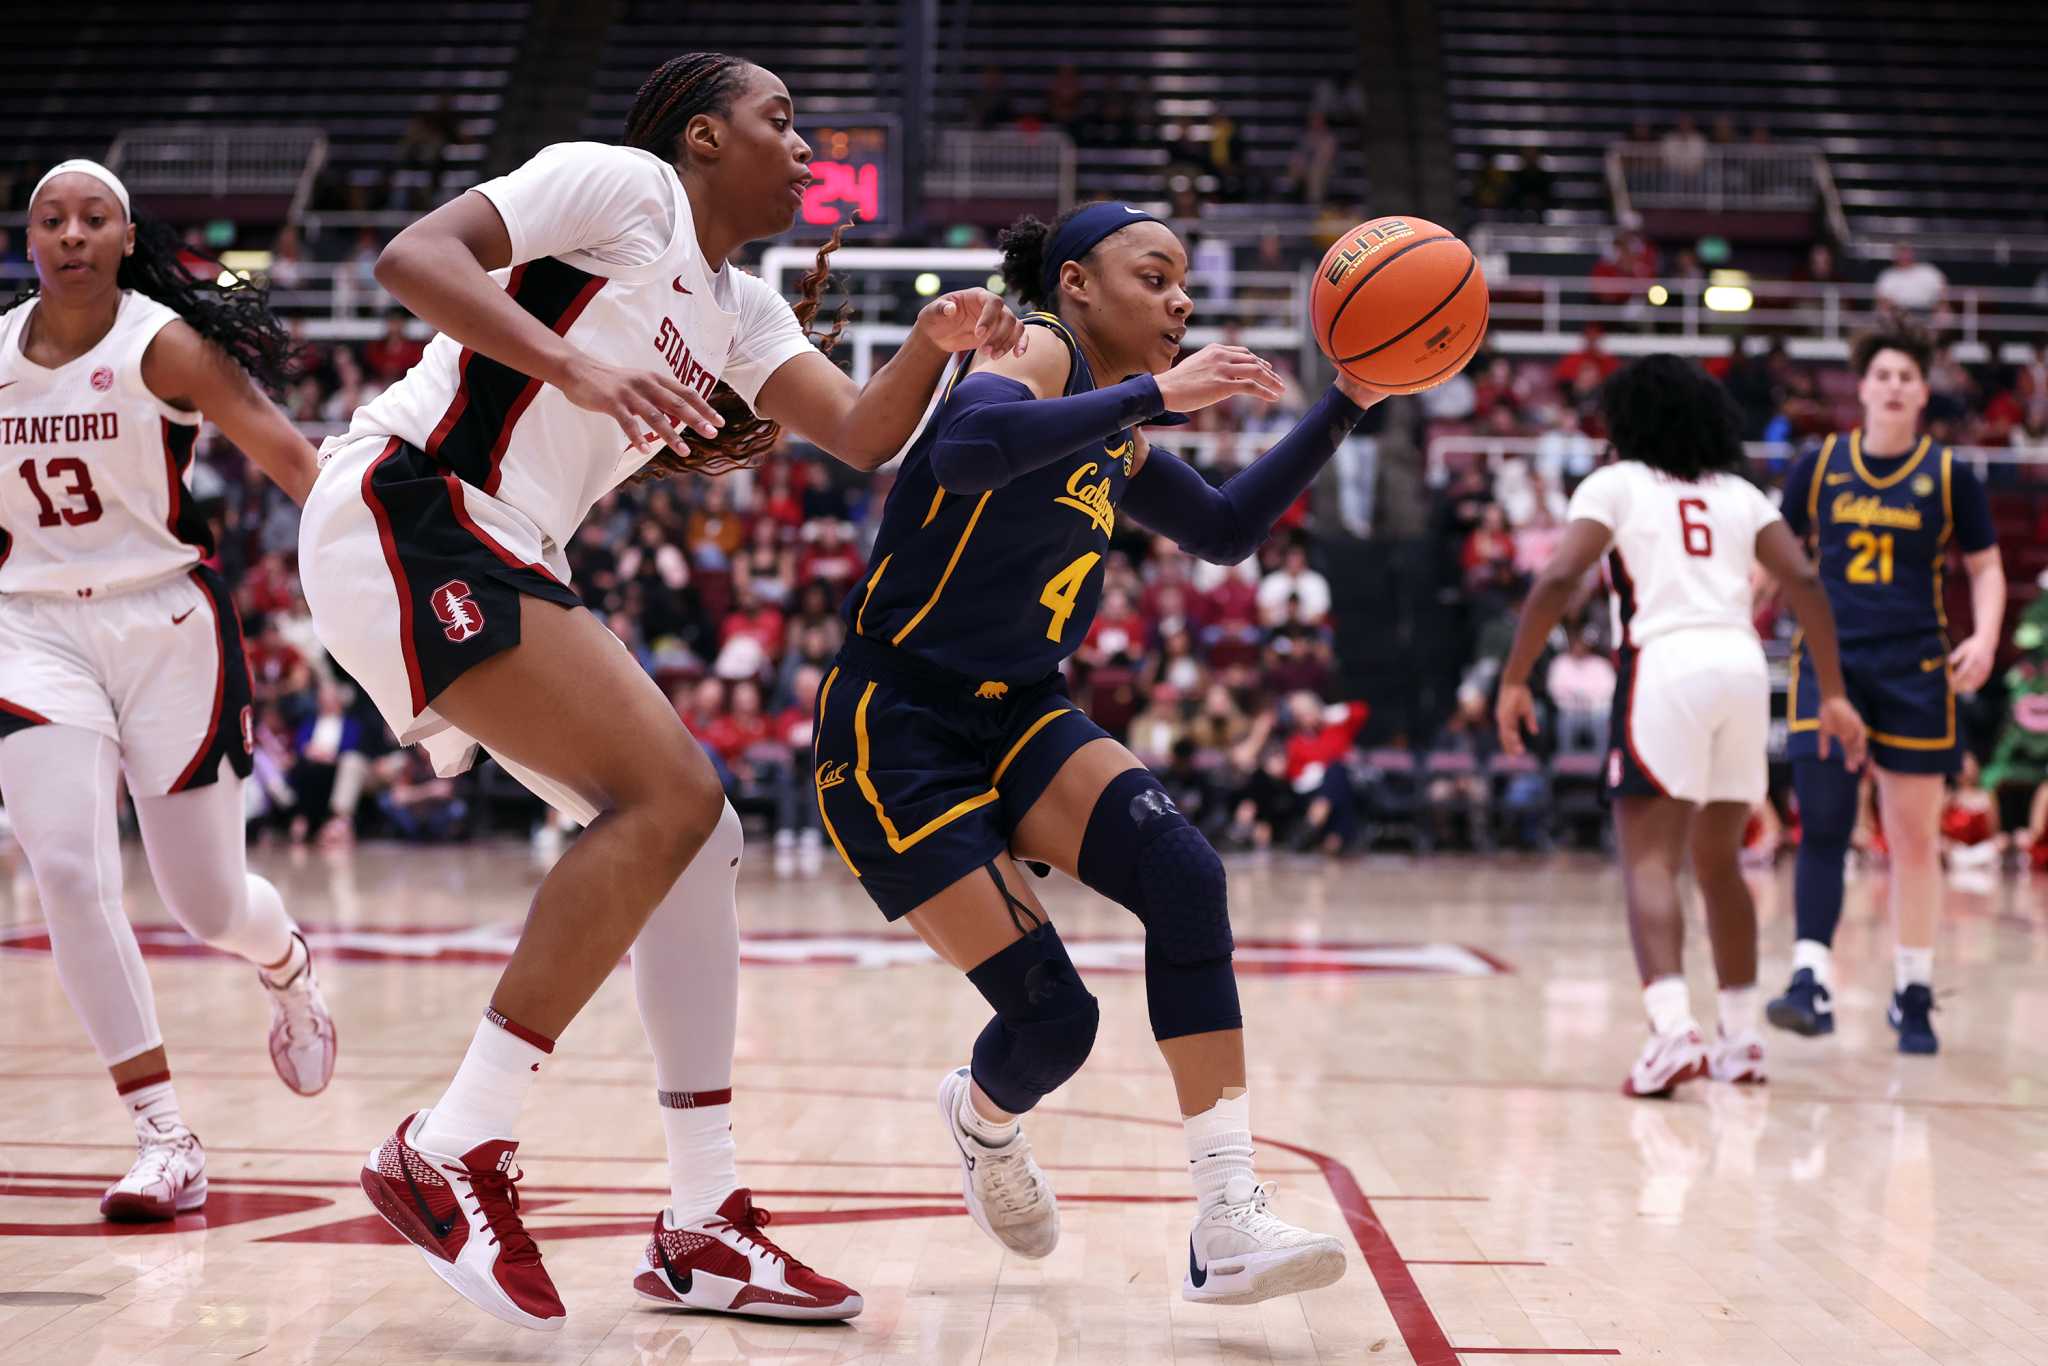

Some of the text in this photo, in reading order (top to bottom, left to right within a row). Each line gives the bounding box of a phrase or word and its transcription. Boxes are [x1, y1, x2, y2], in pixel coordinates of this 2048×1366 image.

[802, 161, 878, 225] 24
[1325, 220, 1412, 287] ELITE
[1337, 229, 1416, 293] AMPIONSHIP
[0, 412, 119, 445] TANFORD
[18, 457, 104, 528] 13
[1678, 498, 1712, 557] 6
[1846, 530, 1894, 584] 21
[1039, 551, 1101, 643] 4
